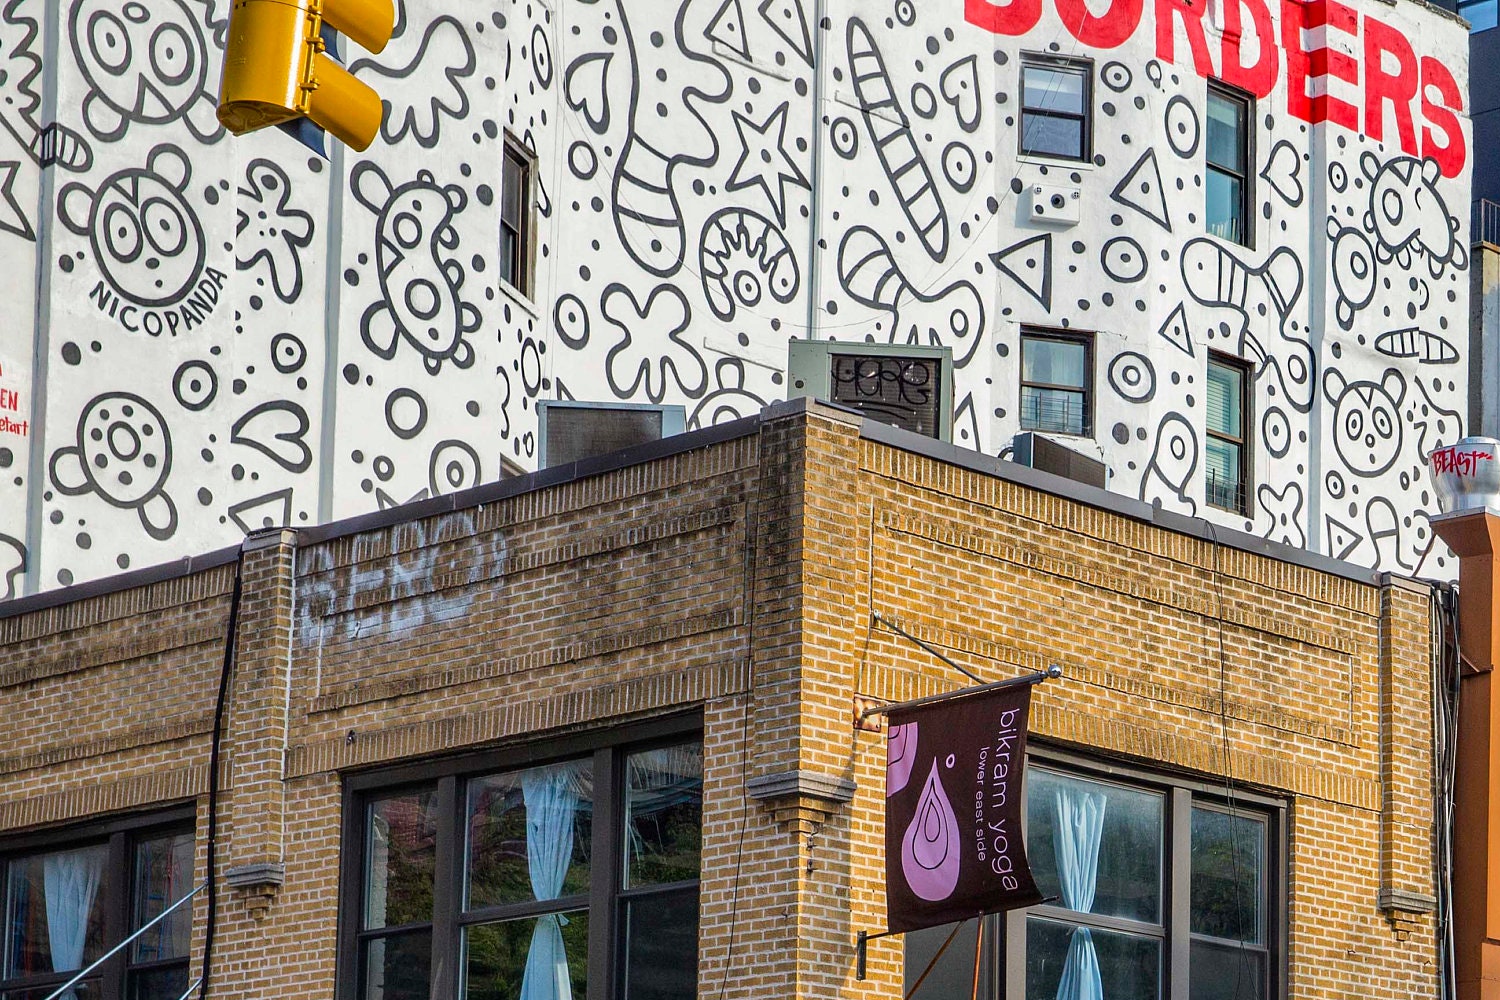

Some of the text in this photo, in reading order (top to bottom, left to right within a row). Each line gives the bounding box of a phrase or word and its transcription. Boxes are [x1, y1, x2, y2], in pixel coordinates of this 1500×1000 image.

[89, 265, 228, 338] NICOPANDA
[1432, 447, 1478, 478] BEAST
[975, 746, 990, 861] lower east side
[988, 708, 1020, 891] bikram yoga
